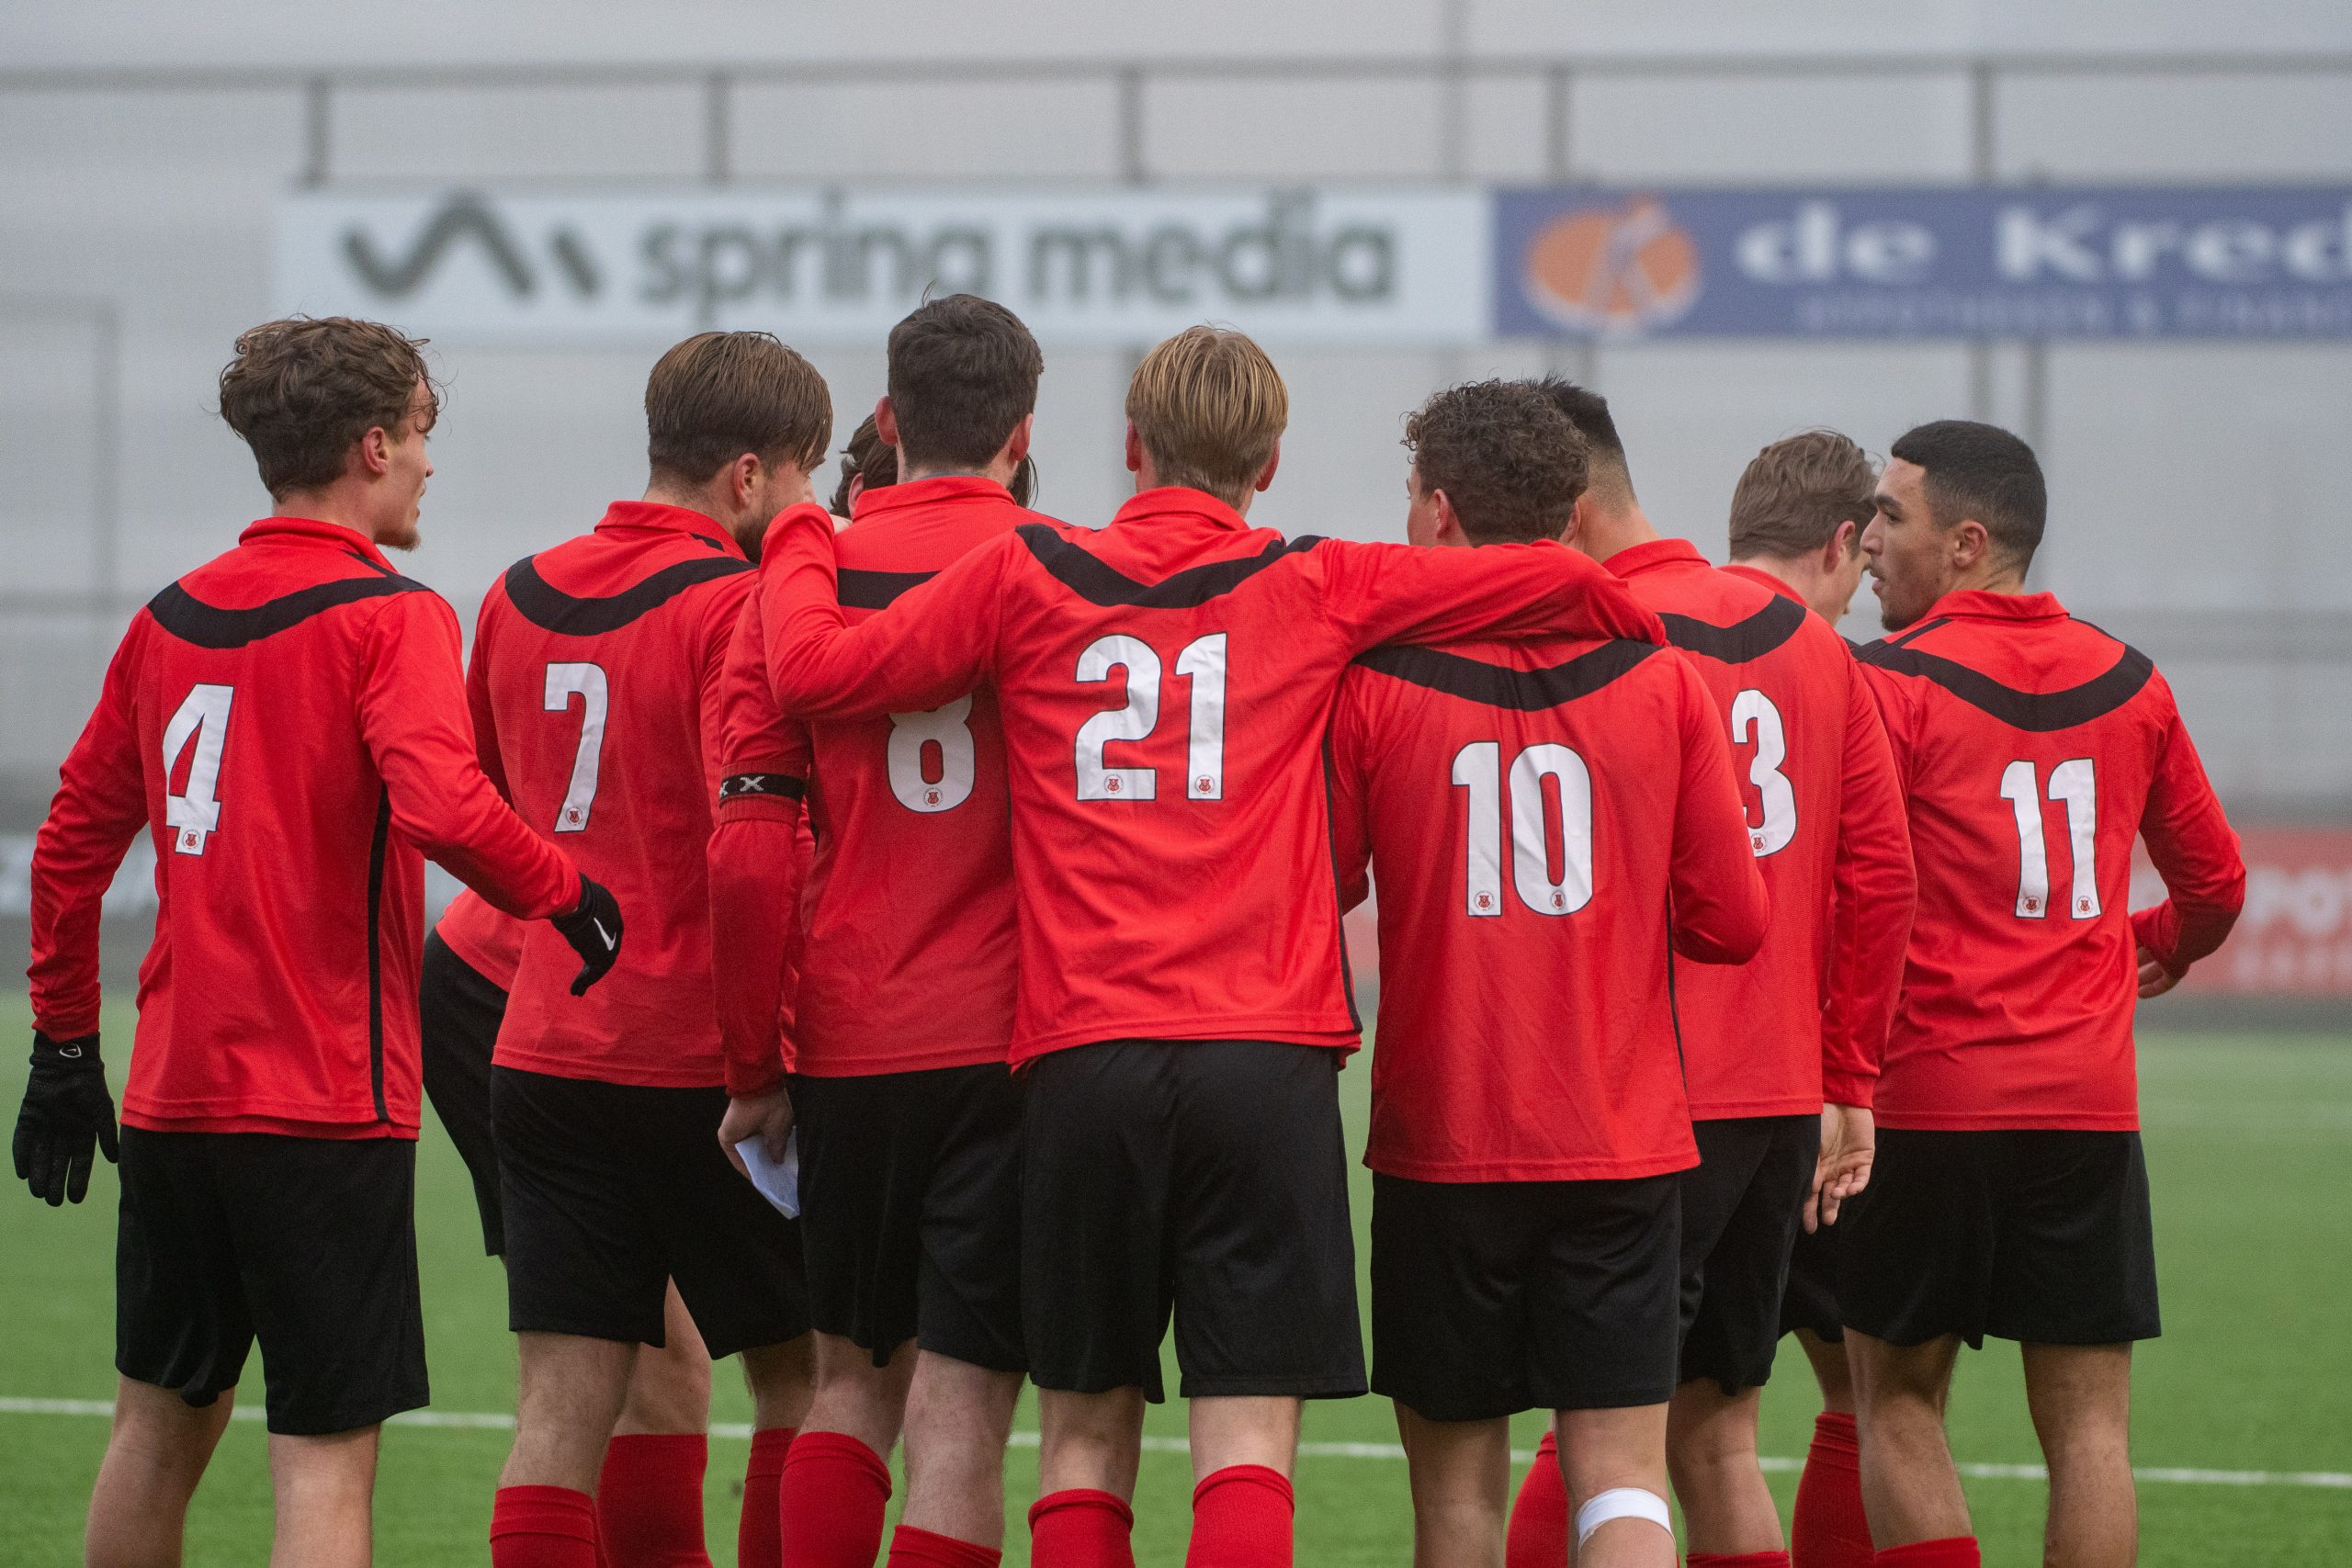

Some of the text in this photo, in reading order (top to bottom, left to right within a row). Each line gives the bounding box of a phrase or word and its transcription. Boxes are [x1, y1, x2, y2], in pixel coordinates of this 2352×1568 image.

[1027, 186, 1402, 303] media
[1733, 197, 1940, 283] de
[163, 682, 235, 856] 4
[543, 661, 608, 833] 7
[888, 693, 975, 813] 8
[1075, 632, 1227, 801] 21
[1731, 688, 1797, 857] 3
[1451, 740, 1593, 917] 10
[1999, 757, 2102, 919] 11
